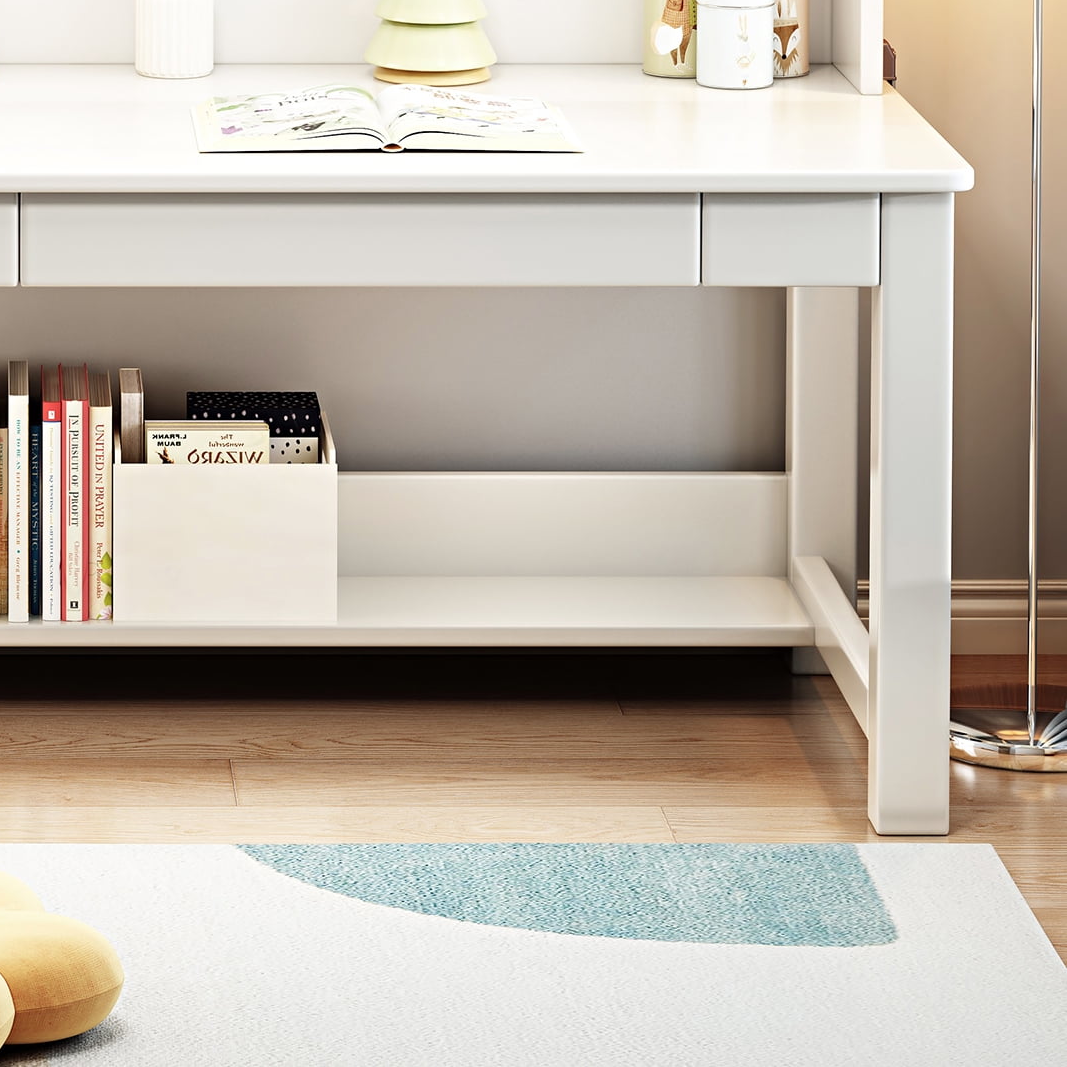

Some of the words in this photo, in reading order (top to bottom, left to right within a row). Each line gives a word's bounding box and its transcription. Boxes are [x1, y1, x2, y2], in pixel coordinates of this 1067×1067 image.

[69, 415, 80, 426] IN
[69, 430, 80, 472] PURSUIT
[95, 424, 105, 471] UNITED
[71, 475, 80, 487] OF
[95, 473, 103, 483] IN
[69, 492, 80, 527] PROFIT
[95, 486, 105, 528] PRAYER
